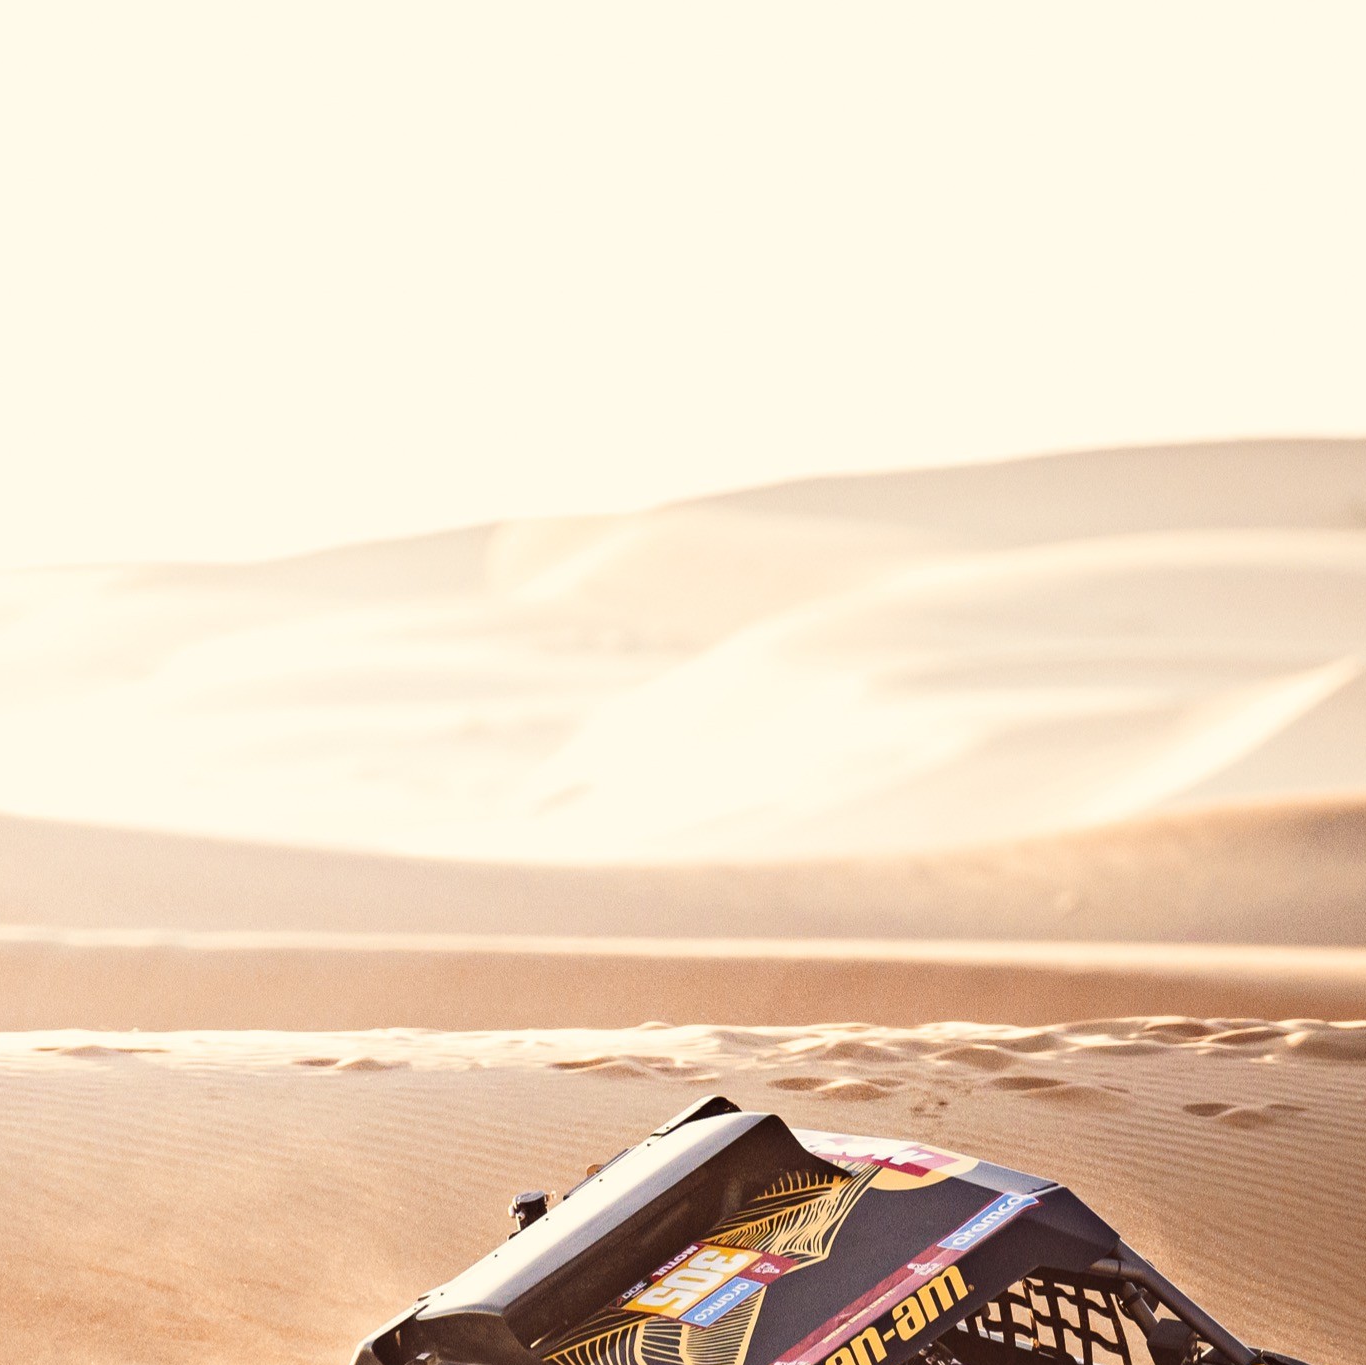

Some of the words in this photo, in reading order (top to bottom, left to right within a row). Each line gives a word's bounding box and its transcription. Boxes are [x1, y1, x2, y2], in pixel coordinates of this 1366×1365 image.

[951, 1196, 1024, 1247] aramco
[638, 1250, 749, 1310] 305
[652, 1244, 700, 1278] MOTUL
[694, 1282, 750, 1322] aramco
